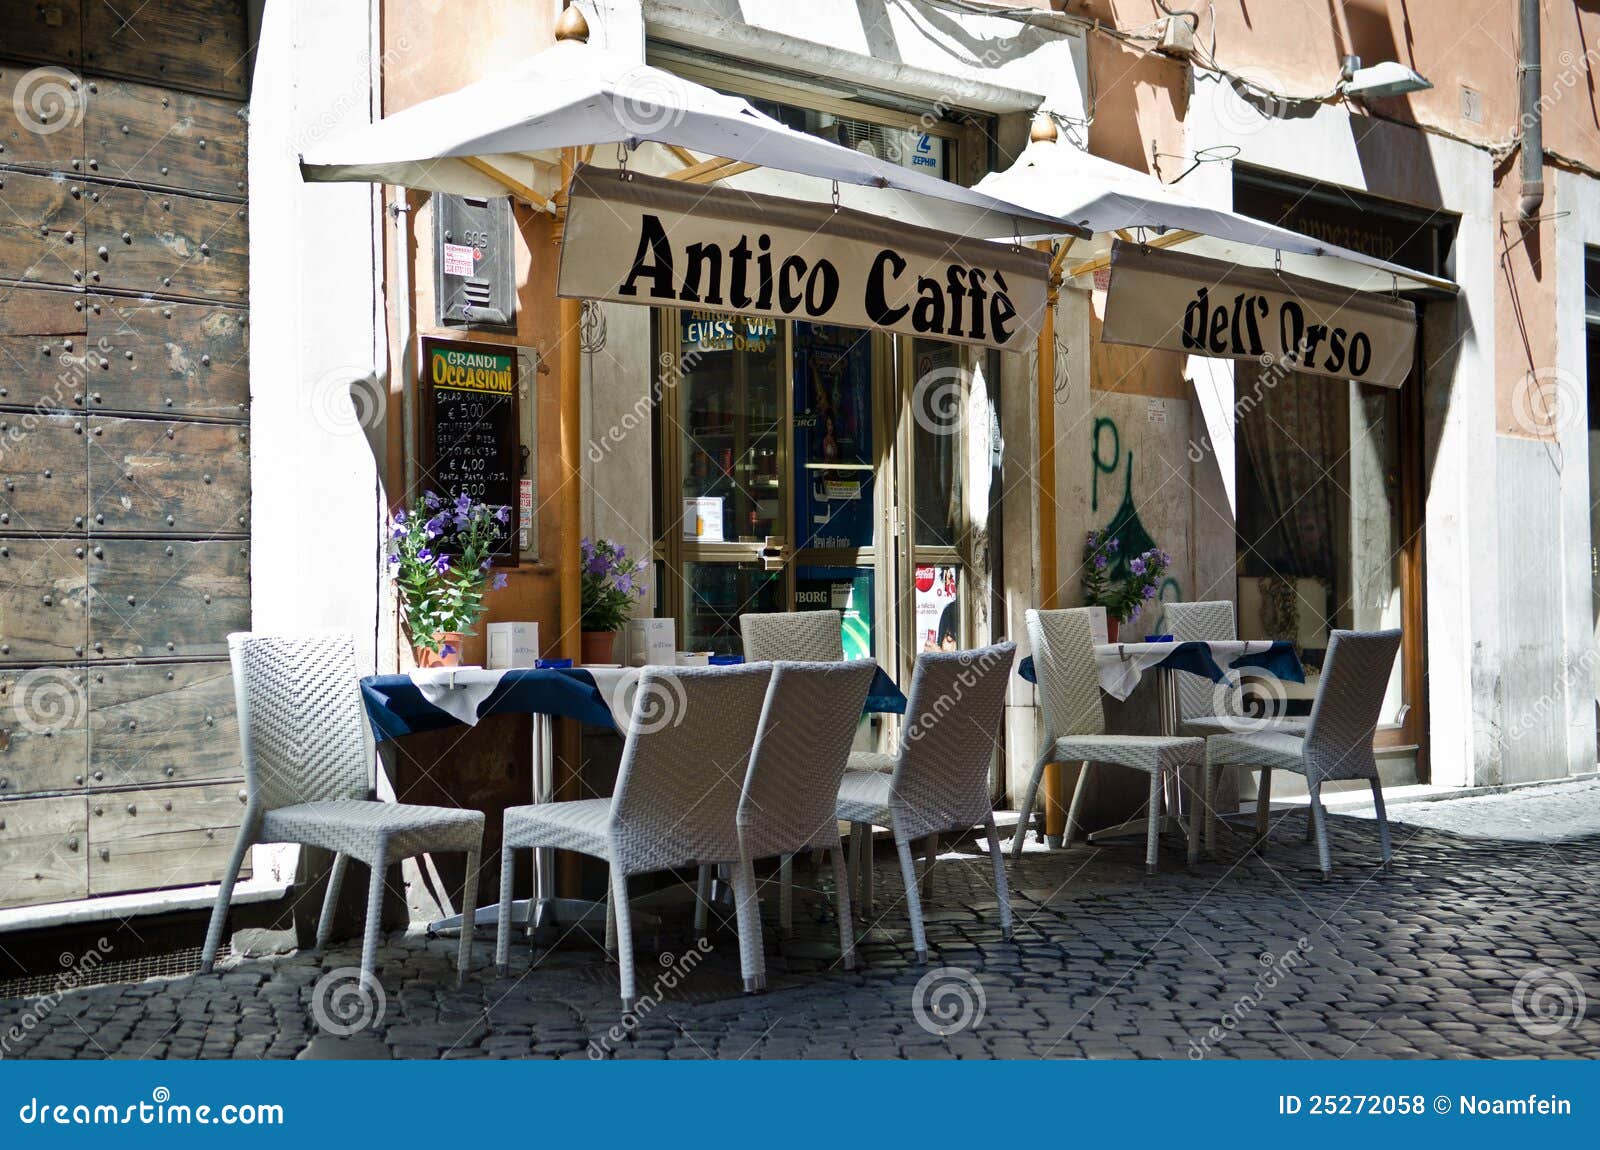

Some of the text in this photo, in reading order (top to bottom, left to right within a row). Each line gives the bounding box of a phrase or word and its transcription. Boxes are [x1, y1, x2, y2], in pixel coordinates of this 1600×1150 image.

[911, 155, 937, 168] ZEPHIR
[463, 230, 489, 249] GAS
[618, 213, 1017, 346] Antico Caffè
[447, 351, 497, 369] GRANDI
[432, 354, 512, 392] OCCASIONI
[461, 458, 485, 472] 4,00
[461, 483, 486, 496] 5,00
[795, 591, 827, 603] BORG
